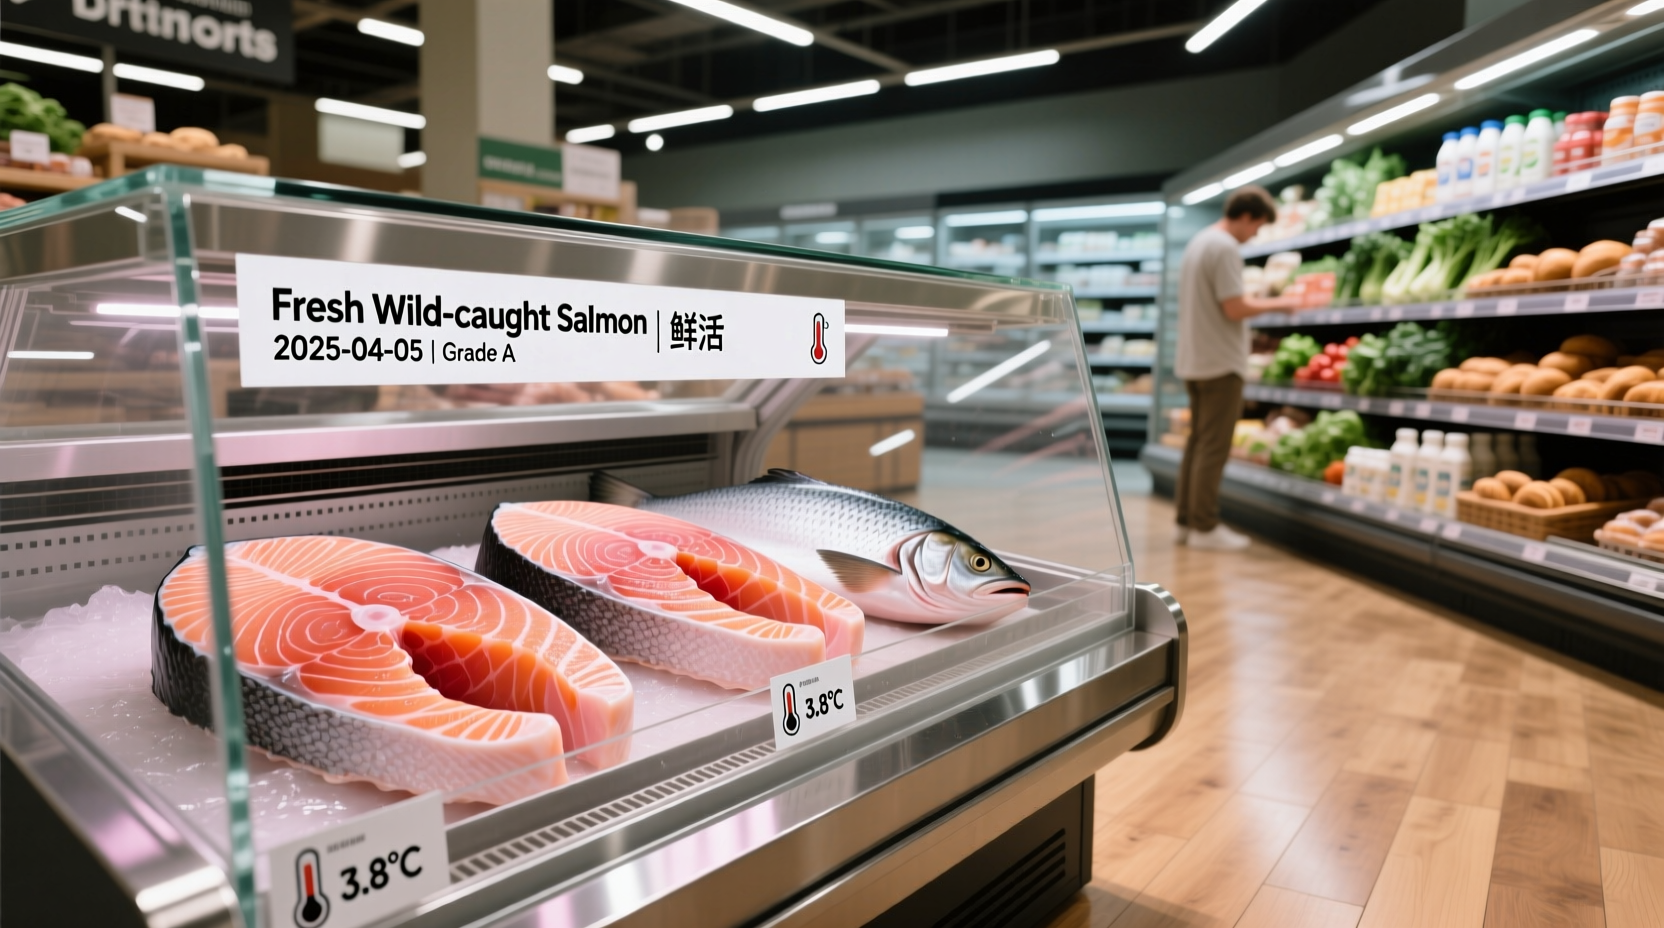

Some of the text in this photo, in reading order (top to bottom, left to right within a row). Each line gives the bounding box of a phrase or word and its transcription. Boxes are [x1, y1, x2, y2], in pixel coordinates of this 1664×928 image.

[272, 287, 648, 339] Fresh Wild-caught Salmon
[670, 310, 725, 352] 鲜活
[273, 334, 516, 365] 2025-04-05 Grade A
[805, 688, 844, 720] 3.8°C
[340, 845, 423, 902] 3.8°C
